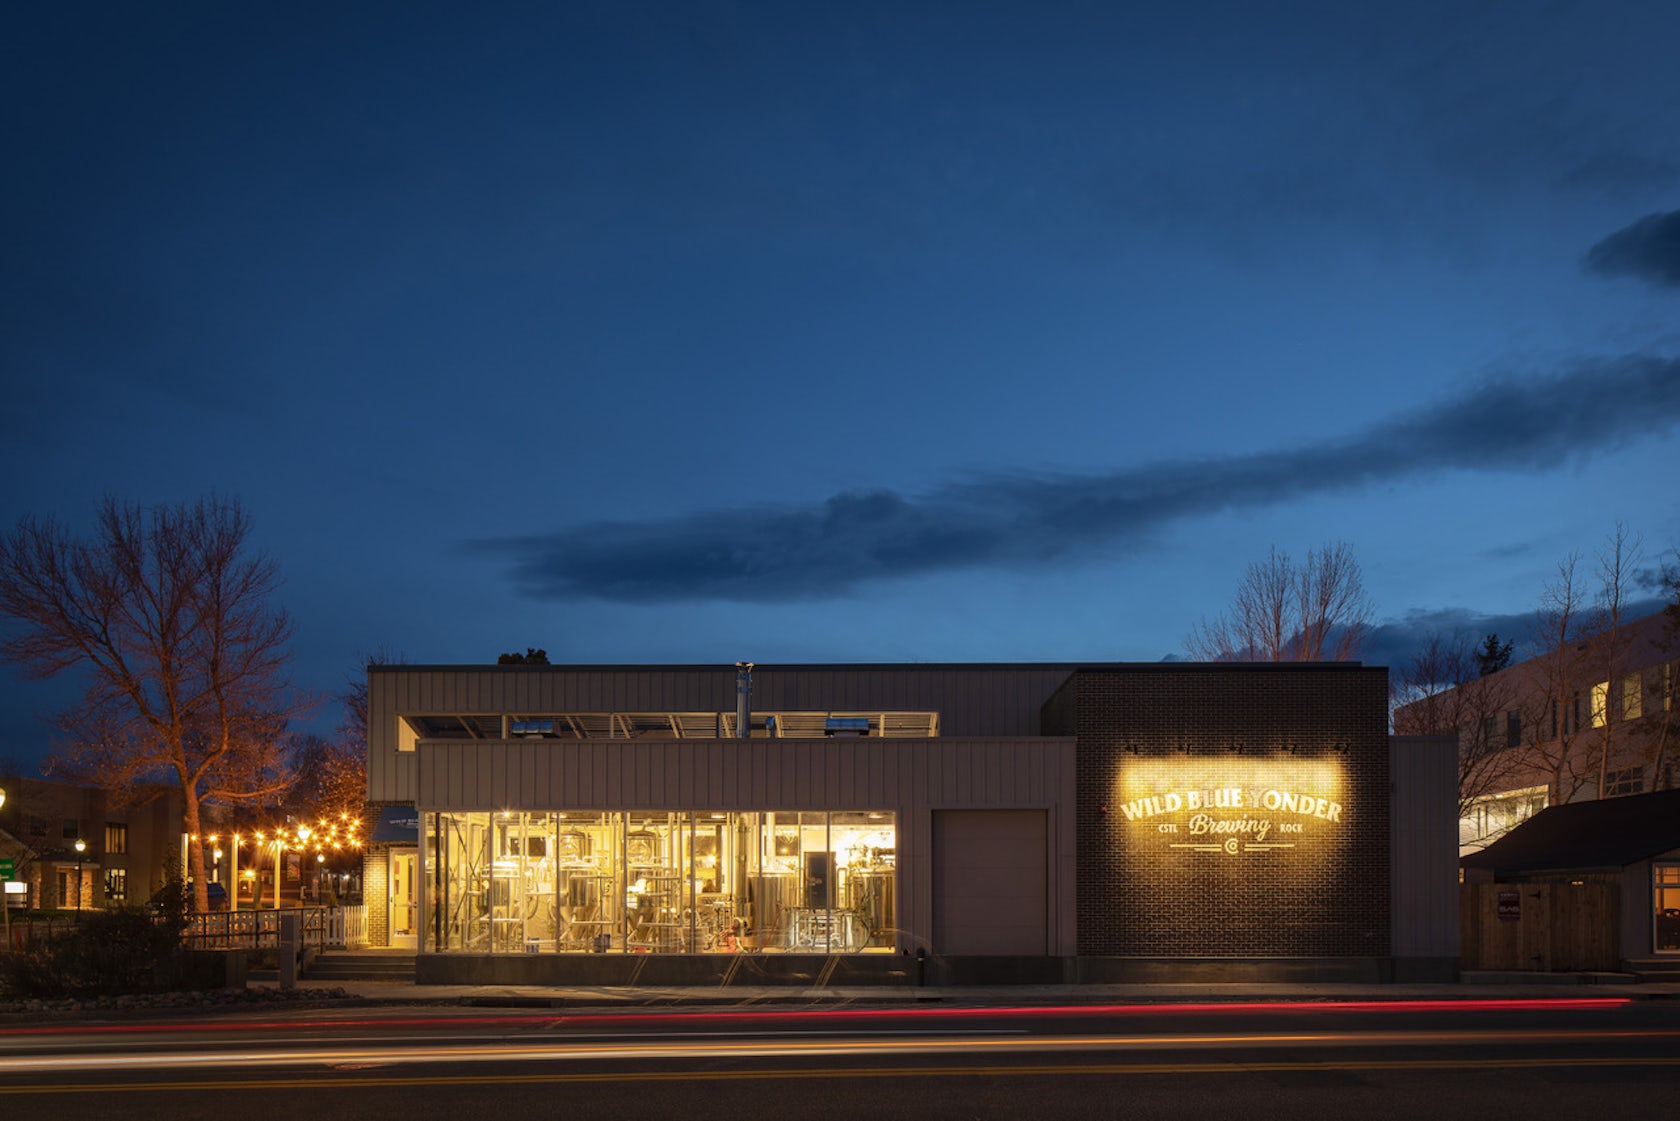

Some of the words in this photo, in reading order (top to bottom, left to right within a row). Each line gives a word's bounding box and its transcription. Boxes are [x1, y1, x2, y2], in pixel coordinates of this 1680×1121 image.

[1120, 793, 1182, 821] WILD
[1187, 788, 1244, 811] BLUE
[1247, 789, 1343, 823] YONDER
[1158, 823, 1178, 833] CSTL
[1188, 813, 1271, 842] Brewing
[1280, 823, 1303, 833] ROCK
